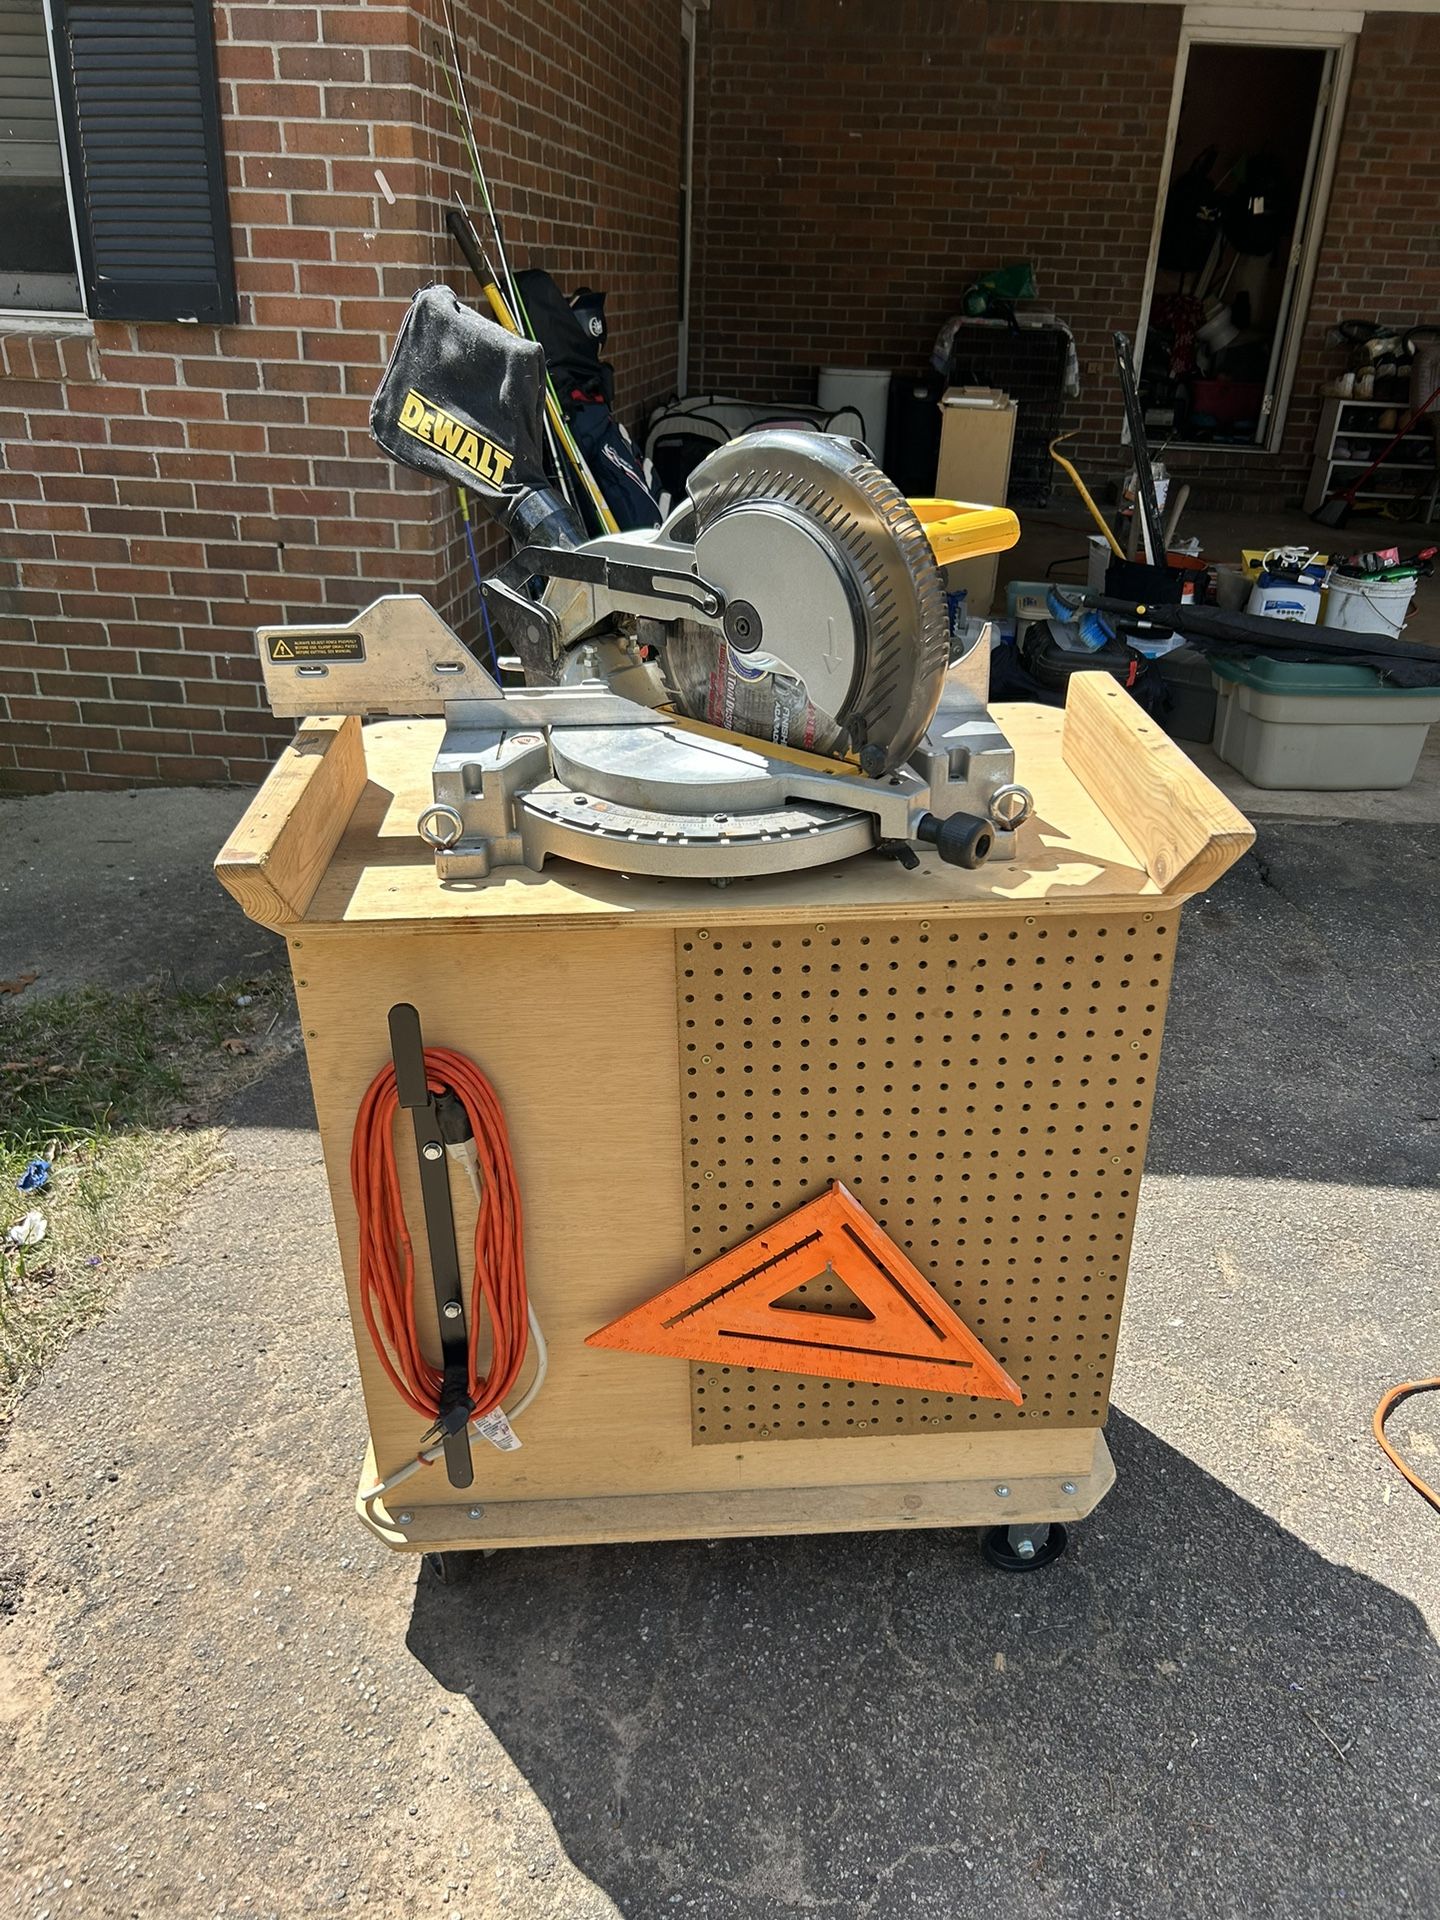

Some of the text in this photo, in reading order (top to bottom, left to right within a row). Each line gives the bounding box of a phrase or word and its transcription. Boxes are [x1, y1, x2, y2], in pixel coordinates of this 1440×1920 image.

[399, 392, 513, 485] DEWALT
[726, 676, 737, 701] Tool
[781, 706, 790, 744] FINISH
